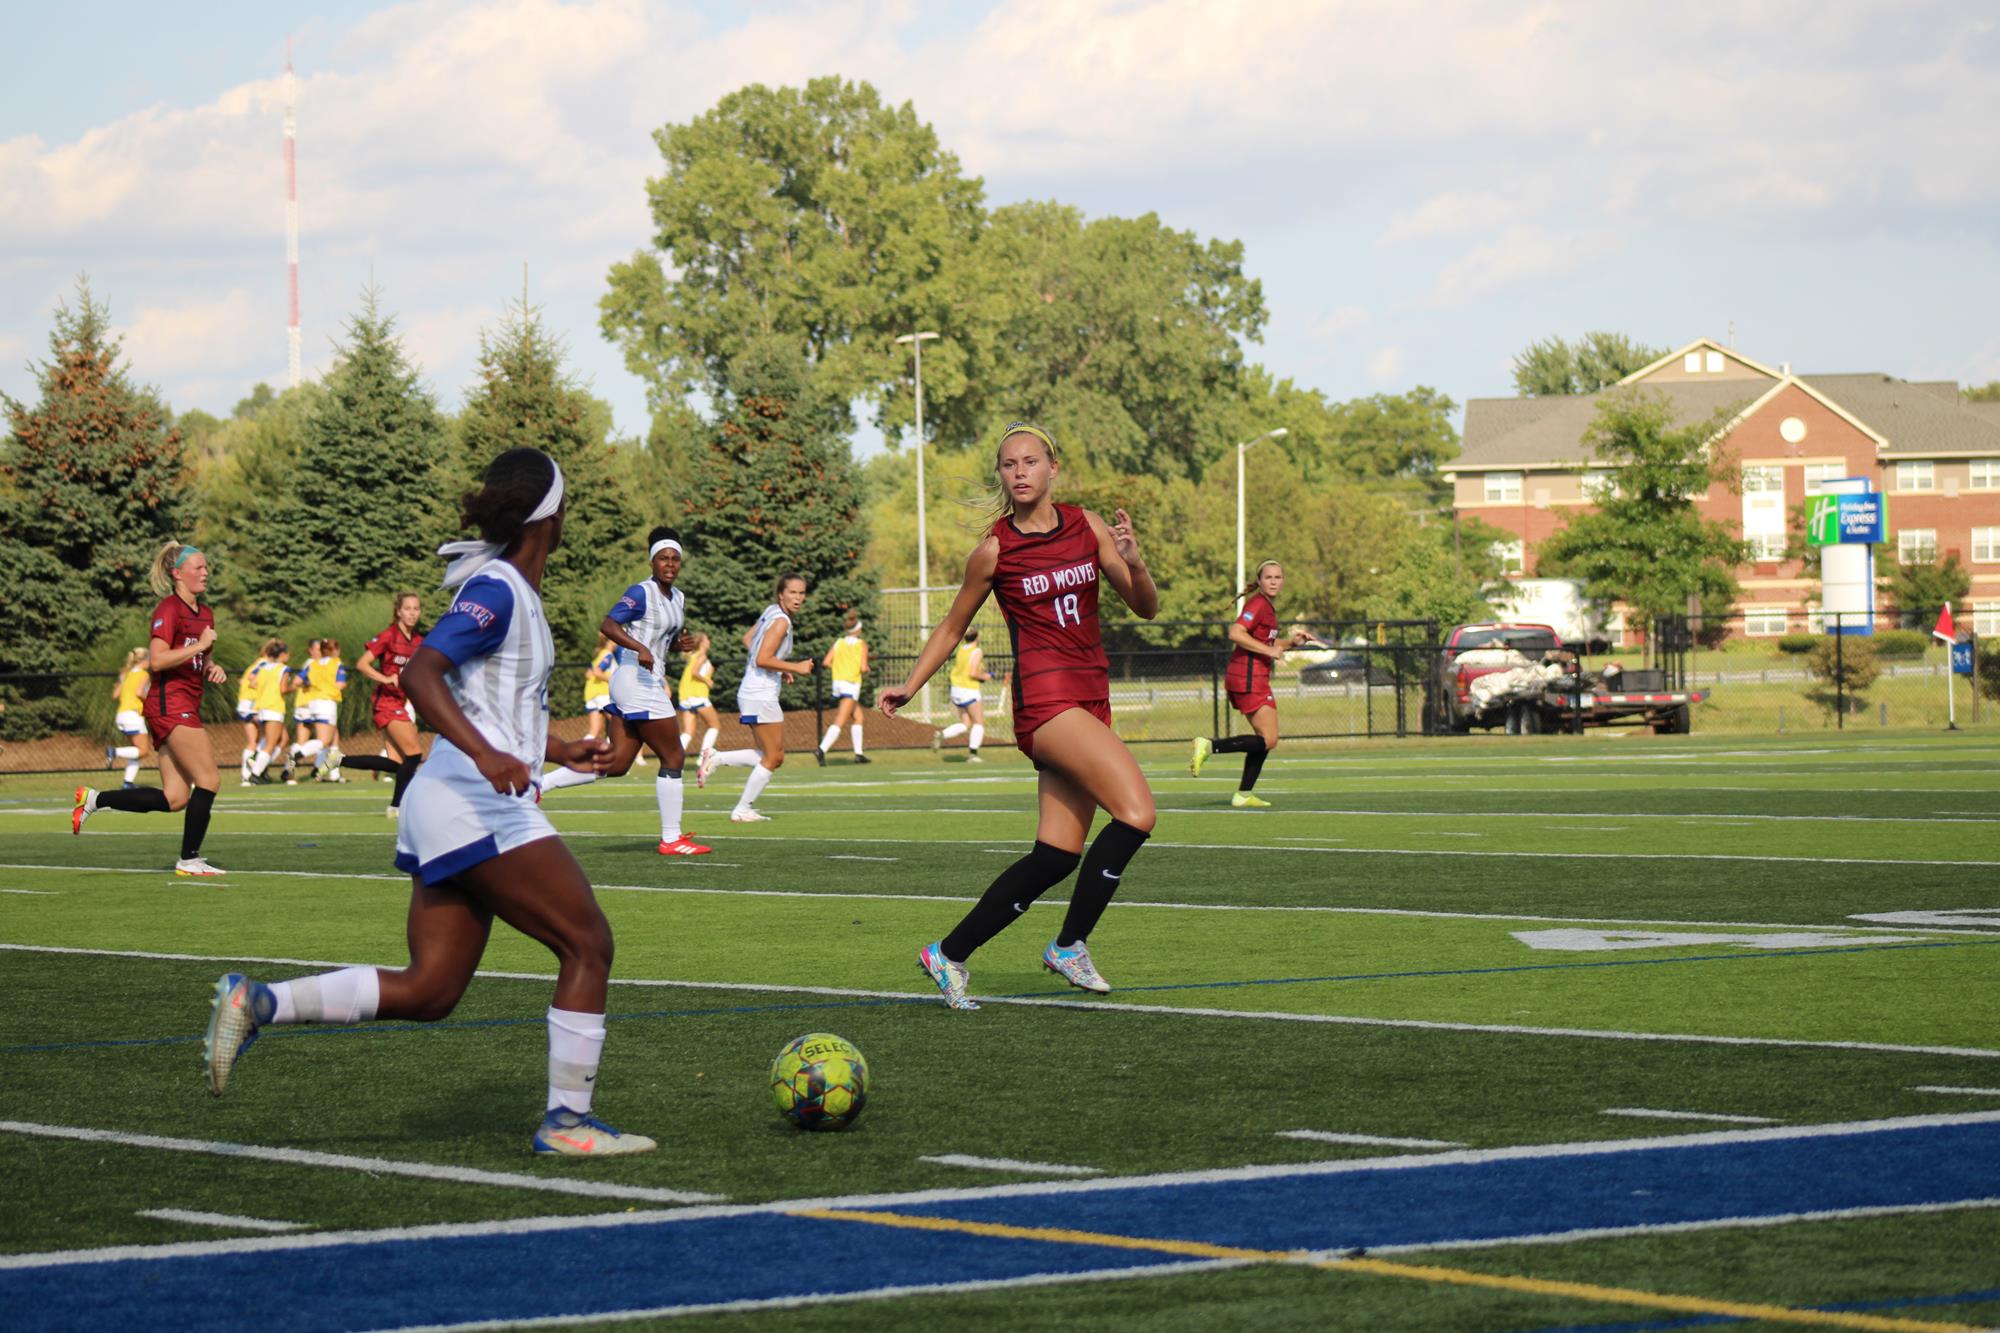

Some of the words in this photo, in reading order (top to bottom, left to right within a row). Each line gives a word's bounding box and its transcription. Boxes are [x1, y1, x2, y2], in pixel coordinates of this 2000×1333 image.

[1022, 575, 1049, 596] RED
[1054, 593, 1081, 628] 19
[804, 1041, 853, 1058] SELEC
